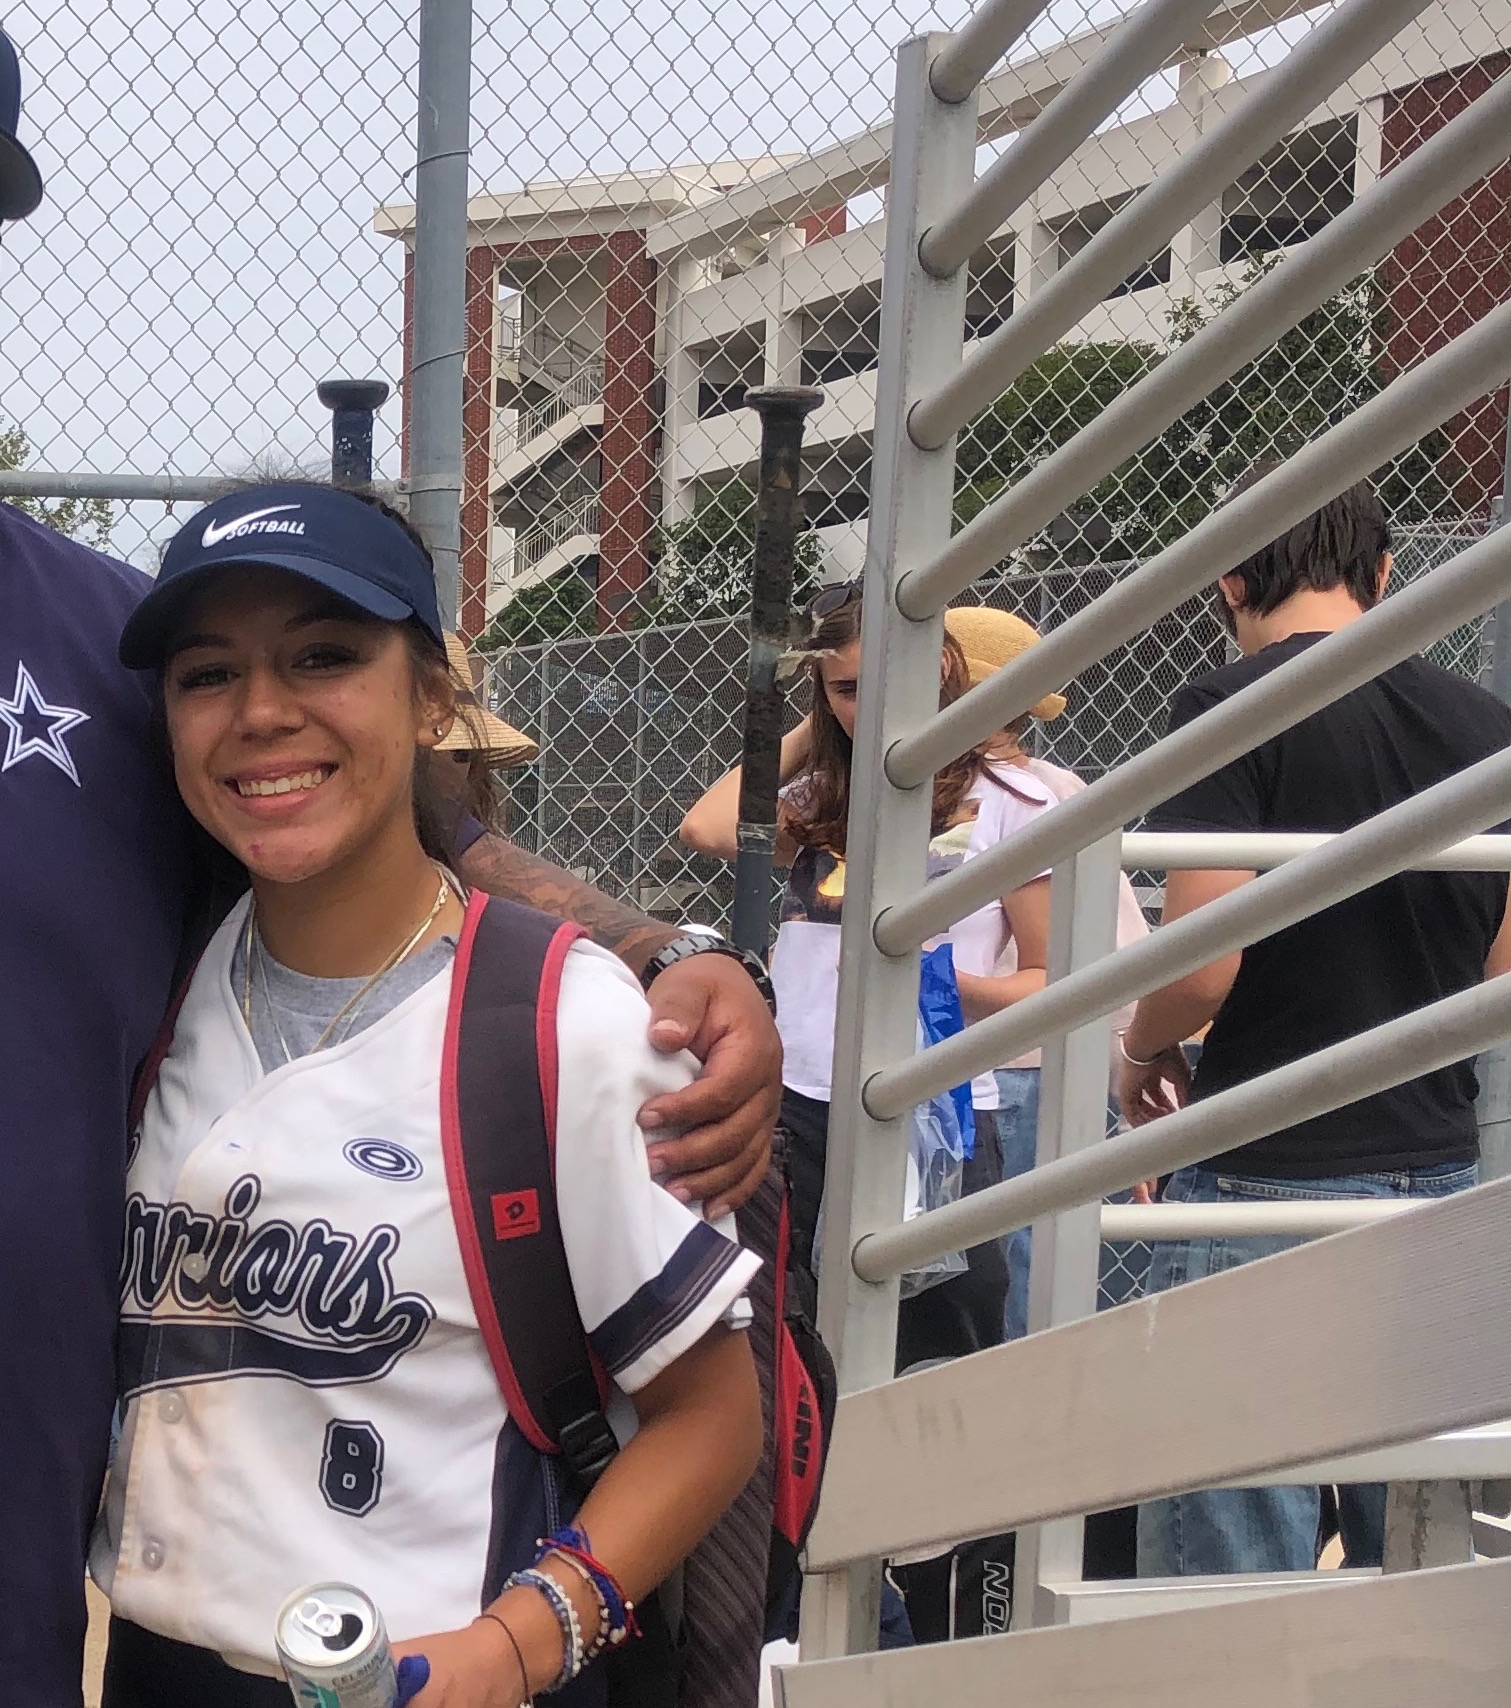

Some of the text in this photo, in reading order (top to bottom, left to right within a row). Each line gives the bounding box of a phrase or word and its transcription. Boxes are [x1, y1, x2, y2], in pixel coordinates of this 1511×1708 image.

[226, 520, 305, 541] SOFTBALL
[120, 1174, 436, 1346] rriors
[319, 1418, 385, 1518] 8
